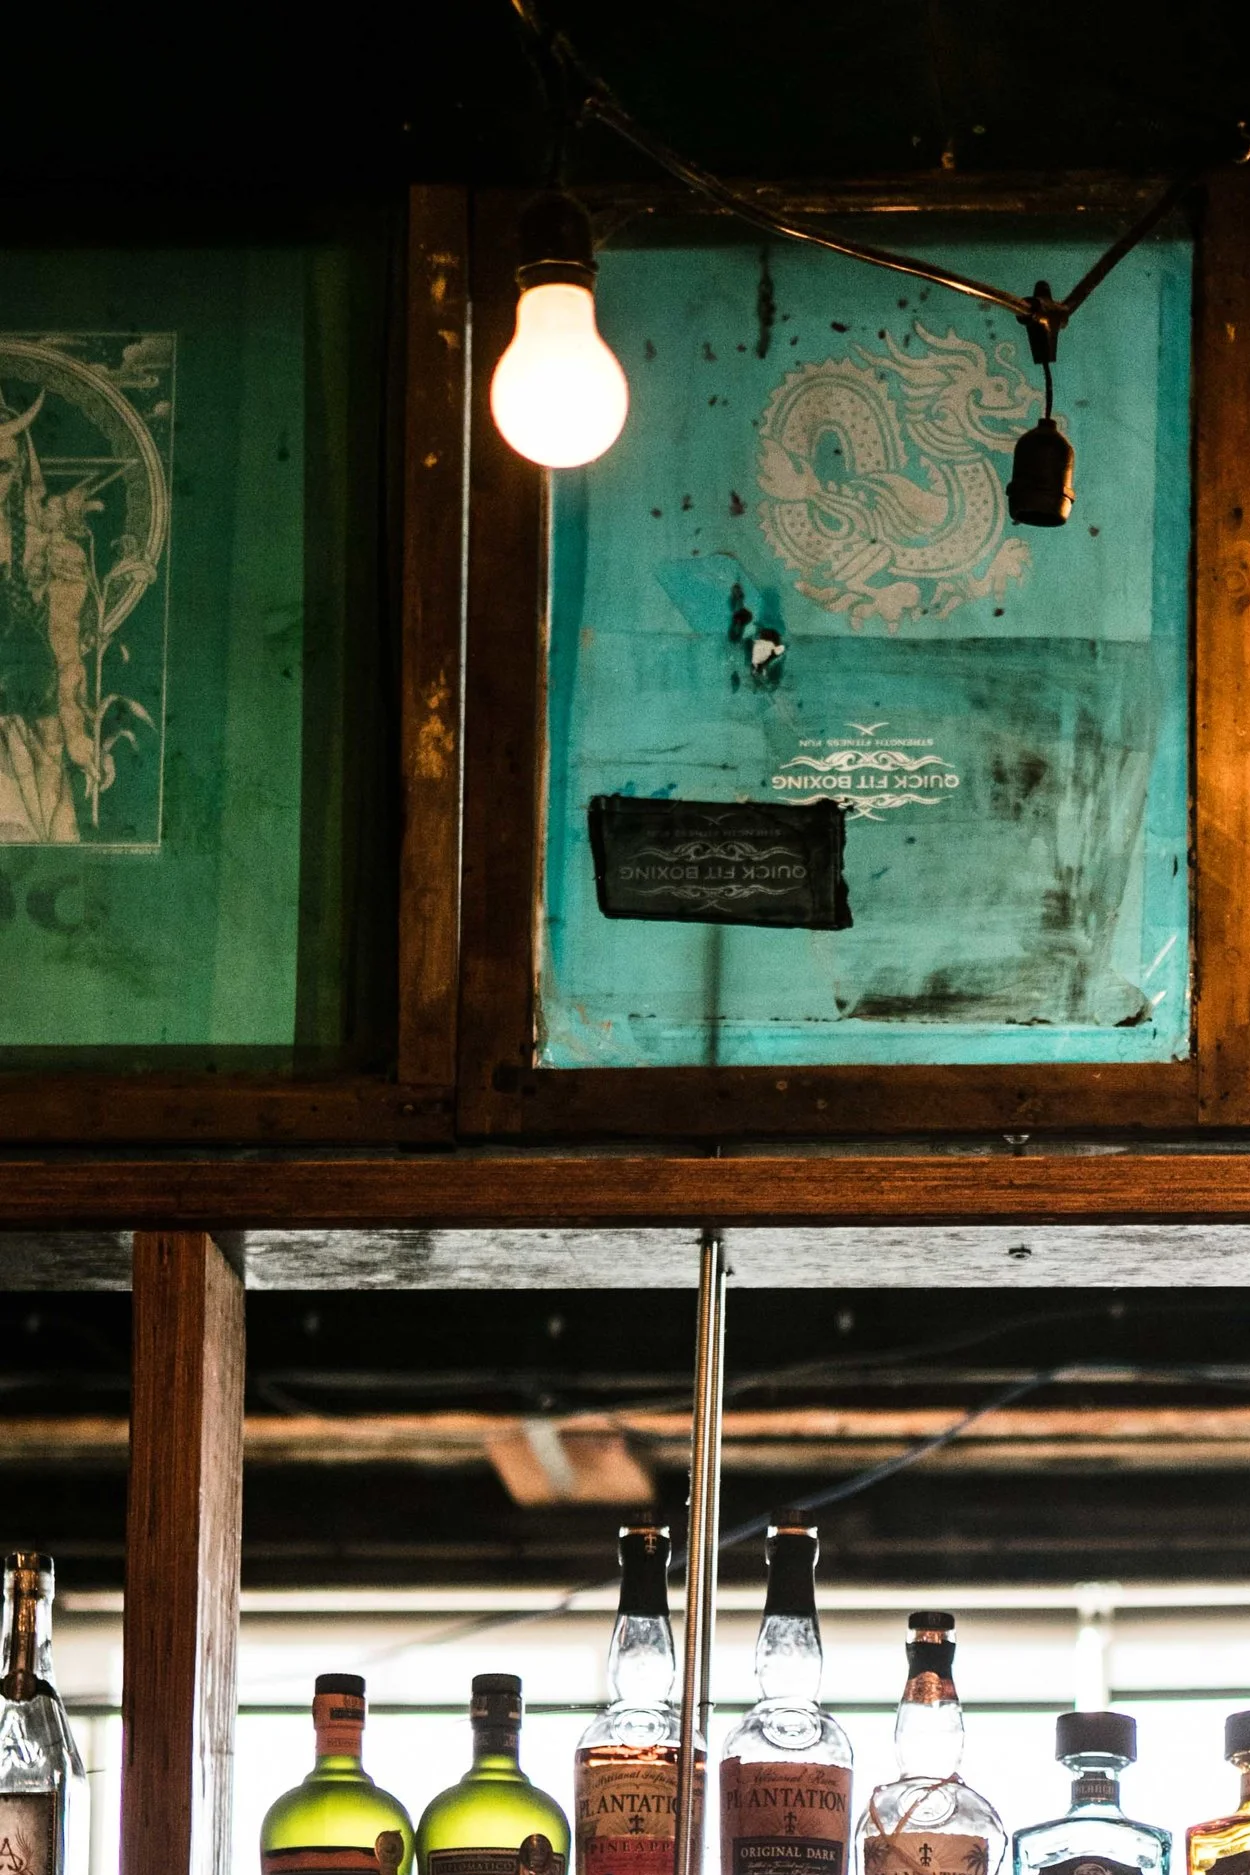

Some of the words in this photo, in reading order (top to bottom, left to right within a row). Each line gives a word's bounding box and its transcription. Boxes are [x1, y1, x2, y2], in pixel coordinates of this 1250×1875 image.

[800, 739, 822, 747] FUN
[827, 739, 872, 747] FITNESS
[876, 739, 934, 747] STRENGTH
[772, 775, 852, 789] BOXING
[856, 775, 888, 789] FIT
[894, 774, 960, 789] QUICK
[619, 865, 701, 880] BOXING
[705, 866, 736, 880] FIT
[742, 865, 808, 880] QUICK
[727, 1788, 847, 1813] PLANTATION
[590, 1841, 671, 1855] PINEAPP
[740, 1845, 802, 1860] ORIGINAL
[806, 1848, 837, 1861] DARK
